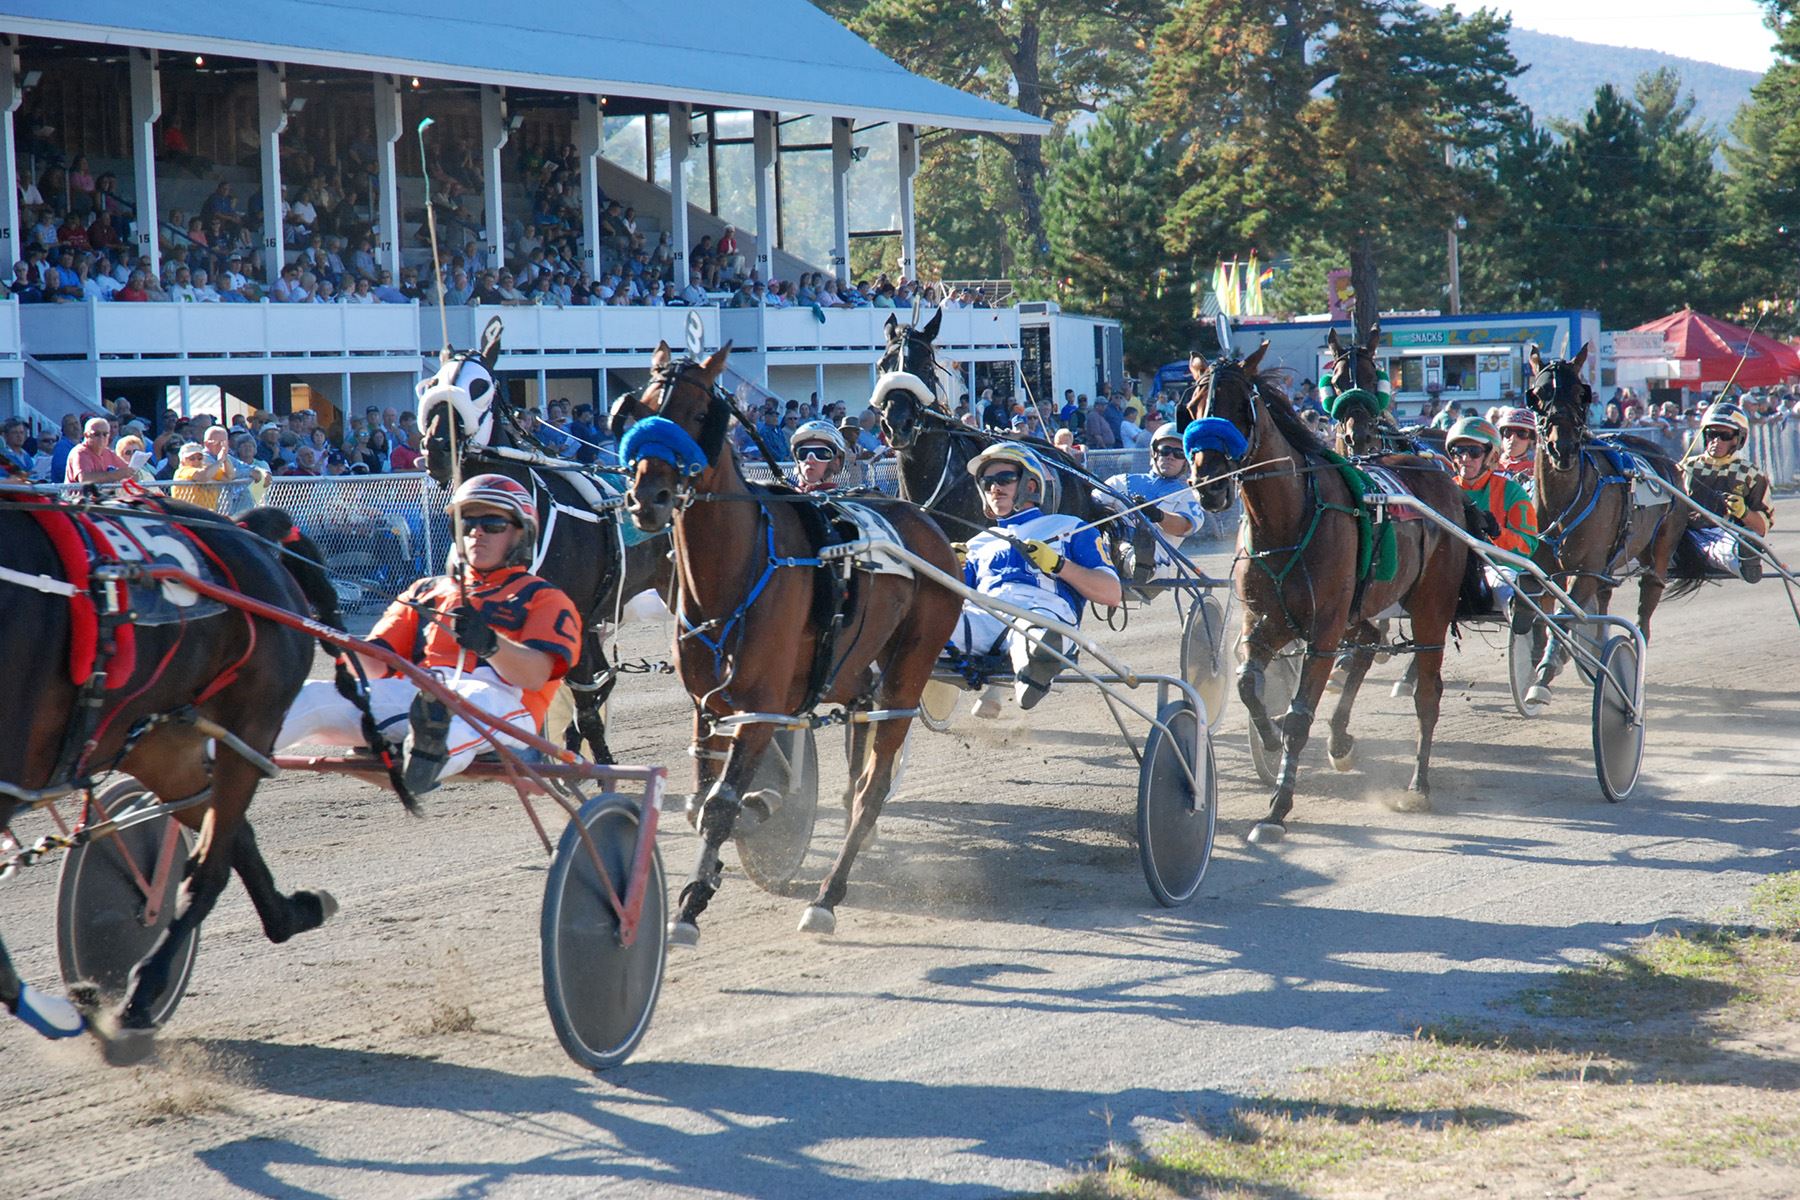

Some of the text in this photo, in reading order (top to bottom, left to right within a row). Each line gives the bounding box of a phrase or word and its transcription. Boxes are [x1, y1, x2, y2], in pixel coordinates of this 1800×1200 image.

[381, 242, 391, 252] 17
[488, 245, 497, 255] 17
[584, 249, 594, 259] 18
[1410, 331, 1443, 344] SNACKS
[1518, 504, 1537, 532] L
